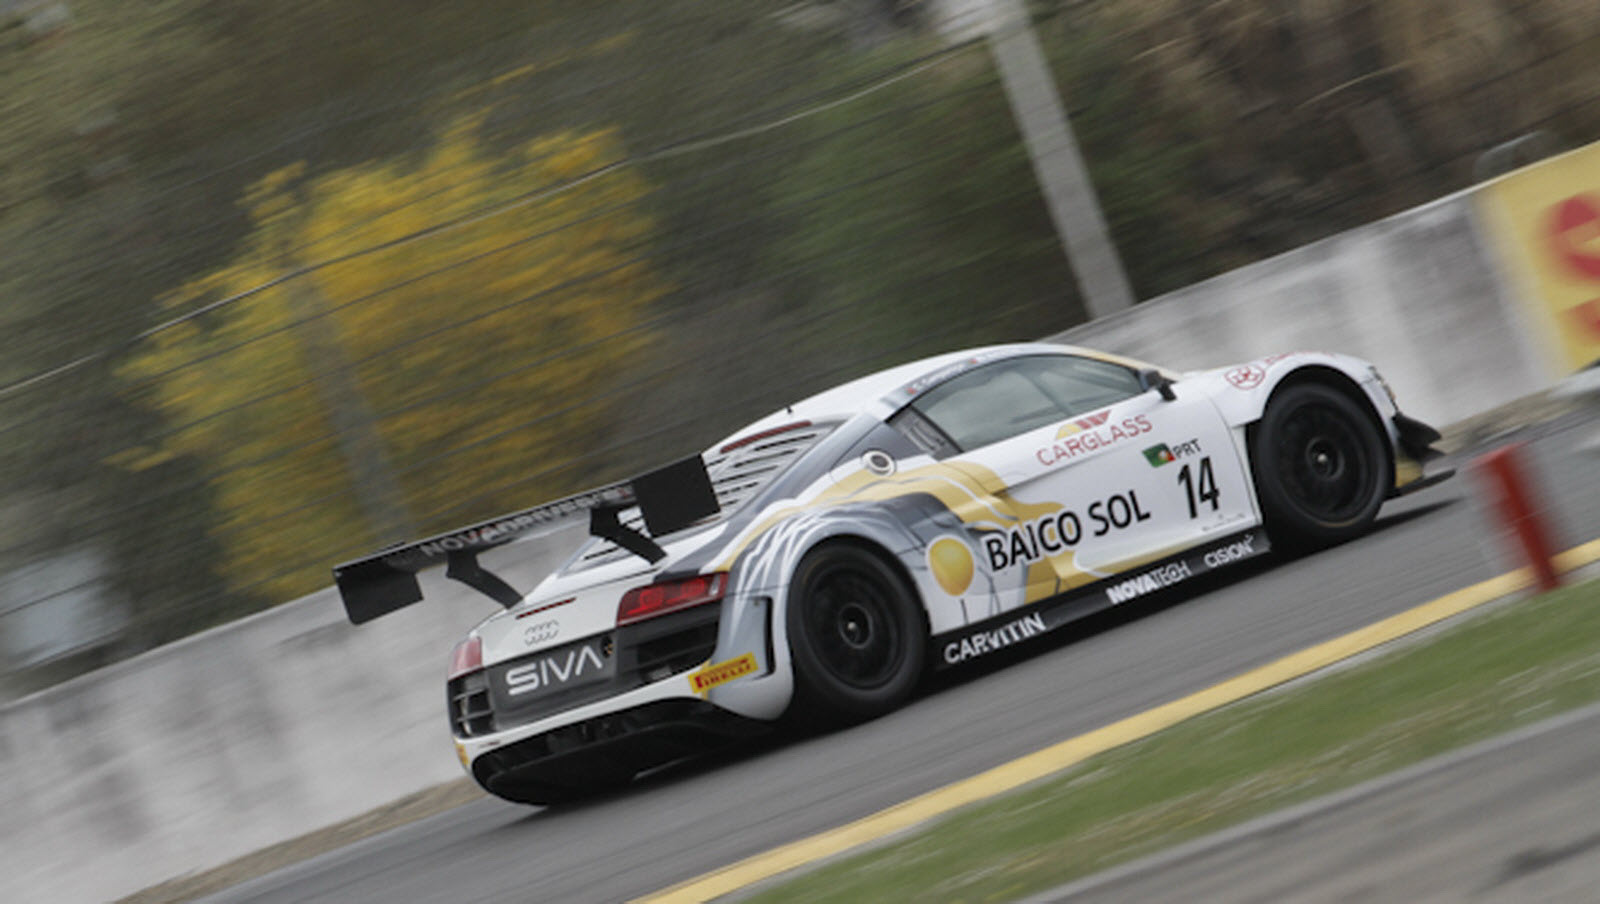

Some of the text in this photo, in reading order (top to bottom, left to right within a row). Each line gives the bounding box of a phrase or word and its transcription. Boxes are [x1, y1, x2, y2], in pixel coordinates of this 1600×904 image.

[1036, 414, 1153, 466] CARGLASS
[1173, 439, 1202, 459] PRT
[1177, 456, 1220, 520] 14
[985, 490, 1151, 572] BAICO SOL
[1107, 562, 1192, 604] NOVATECH
[944, 612, 1047, 665] CARVITIN
[506, 645, 603, 696] SIVA
